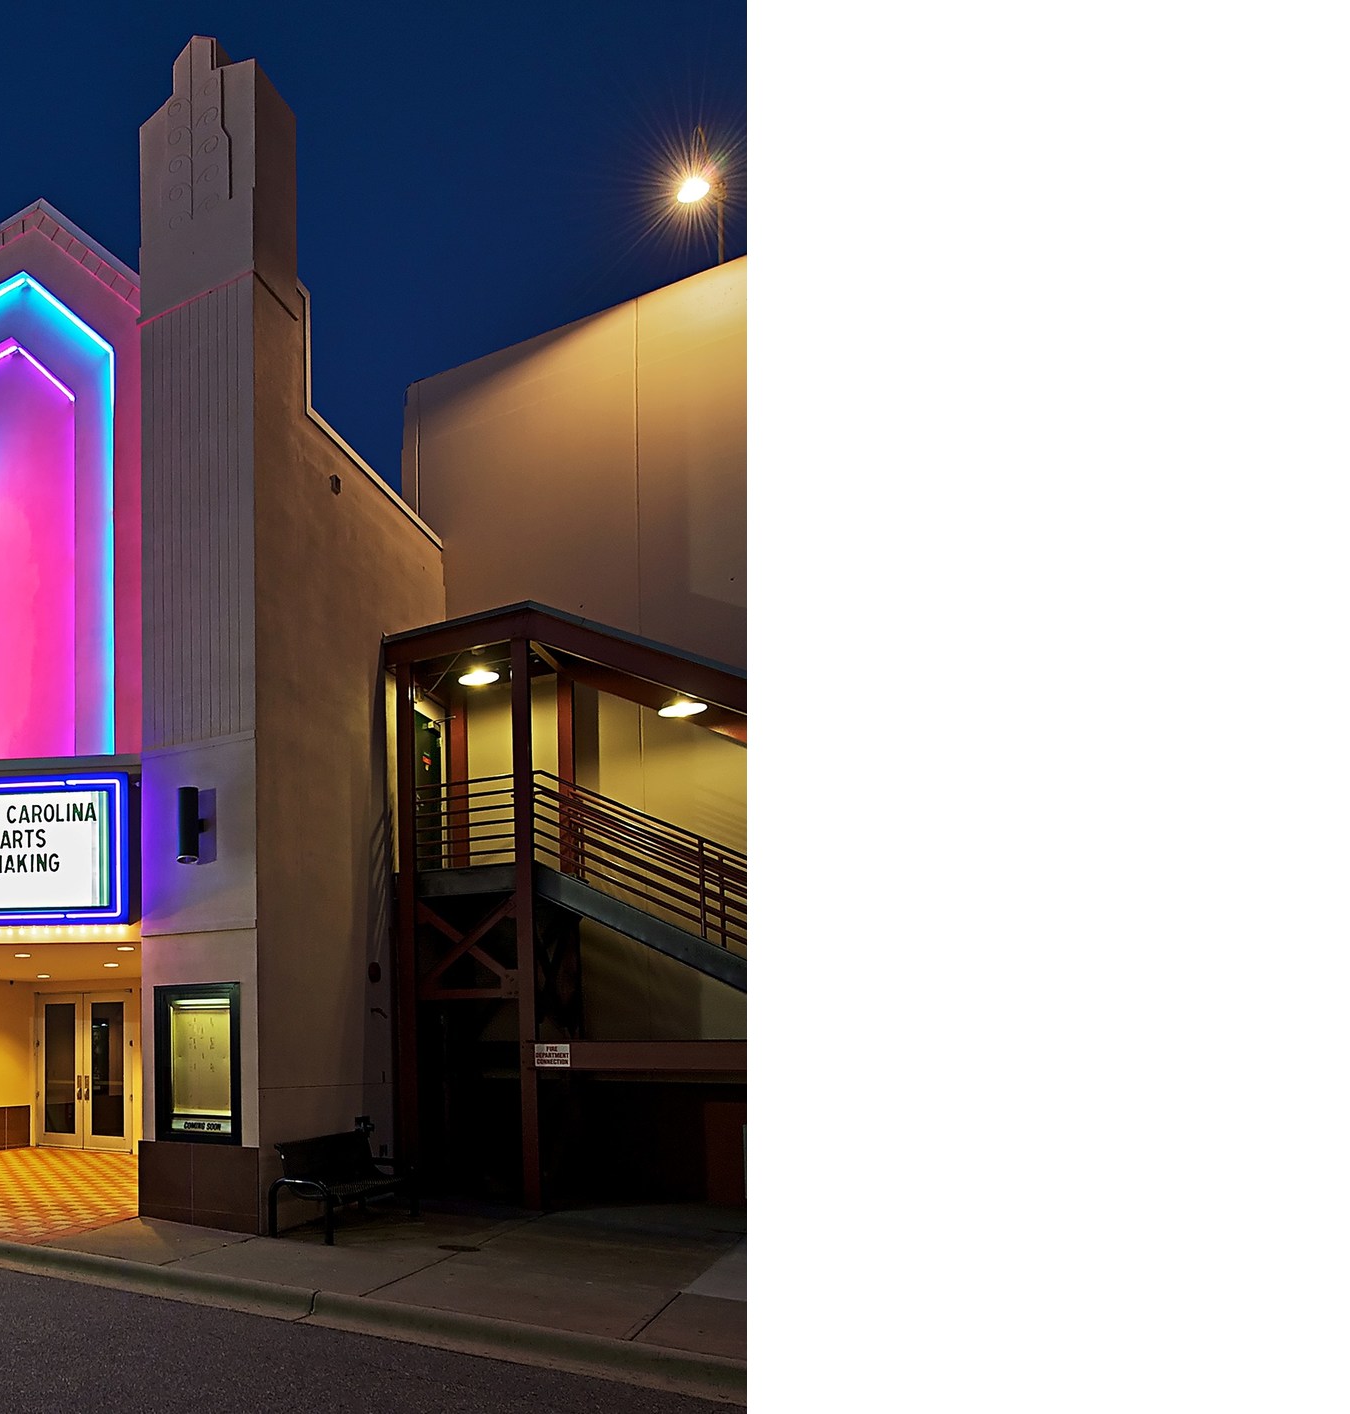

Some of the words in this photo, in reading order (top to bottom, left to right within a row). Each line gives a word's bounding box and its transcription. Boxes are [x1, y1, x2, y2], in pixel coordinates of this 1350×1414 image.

[6, 802, 97, 824] CAROLINA
[0, 828, 47, 849] ARTS
[183, 1121, 206, 1130] COMING
[206, 1122, 222, 1131] SOON
